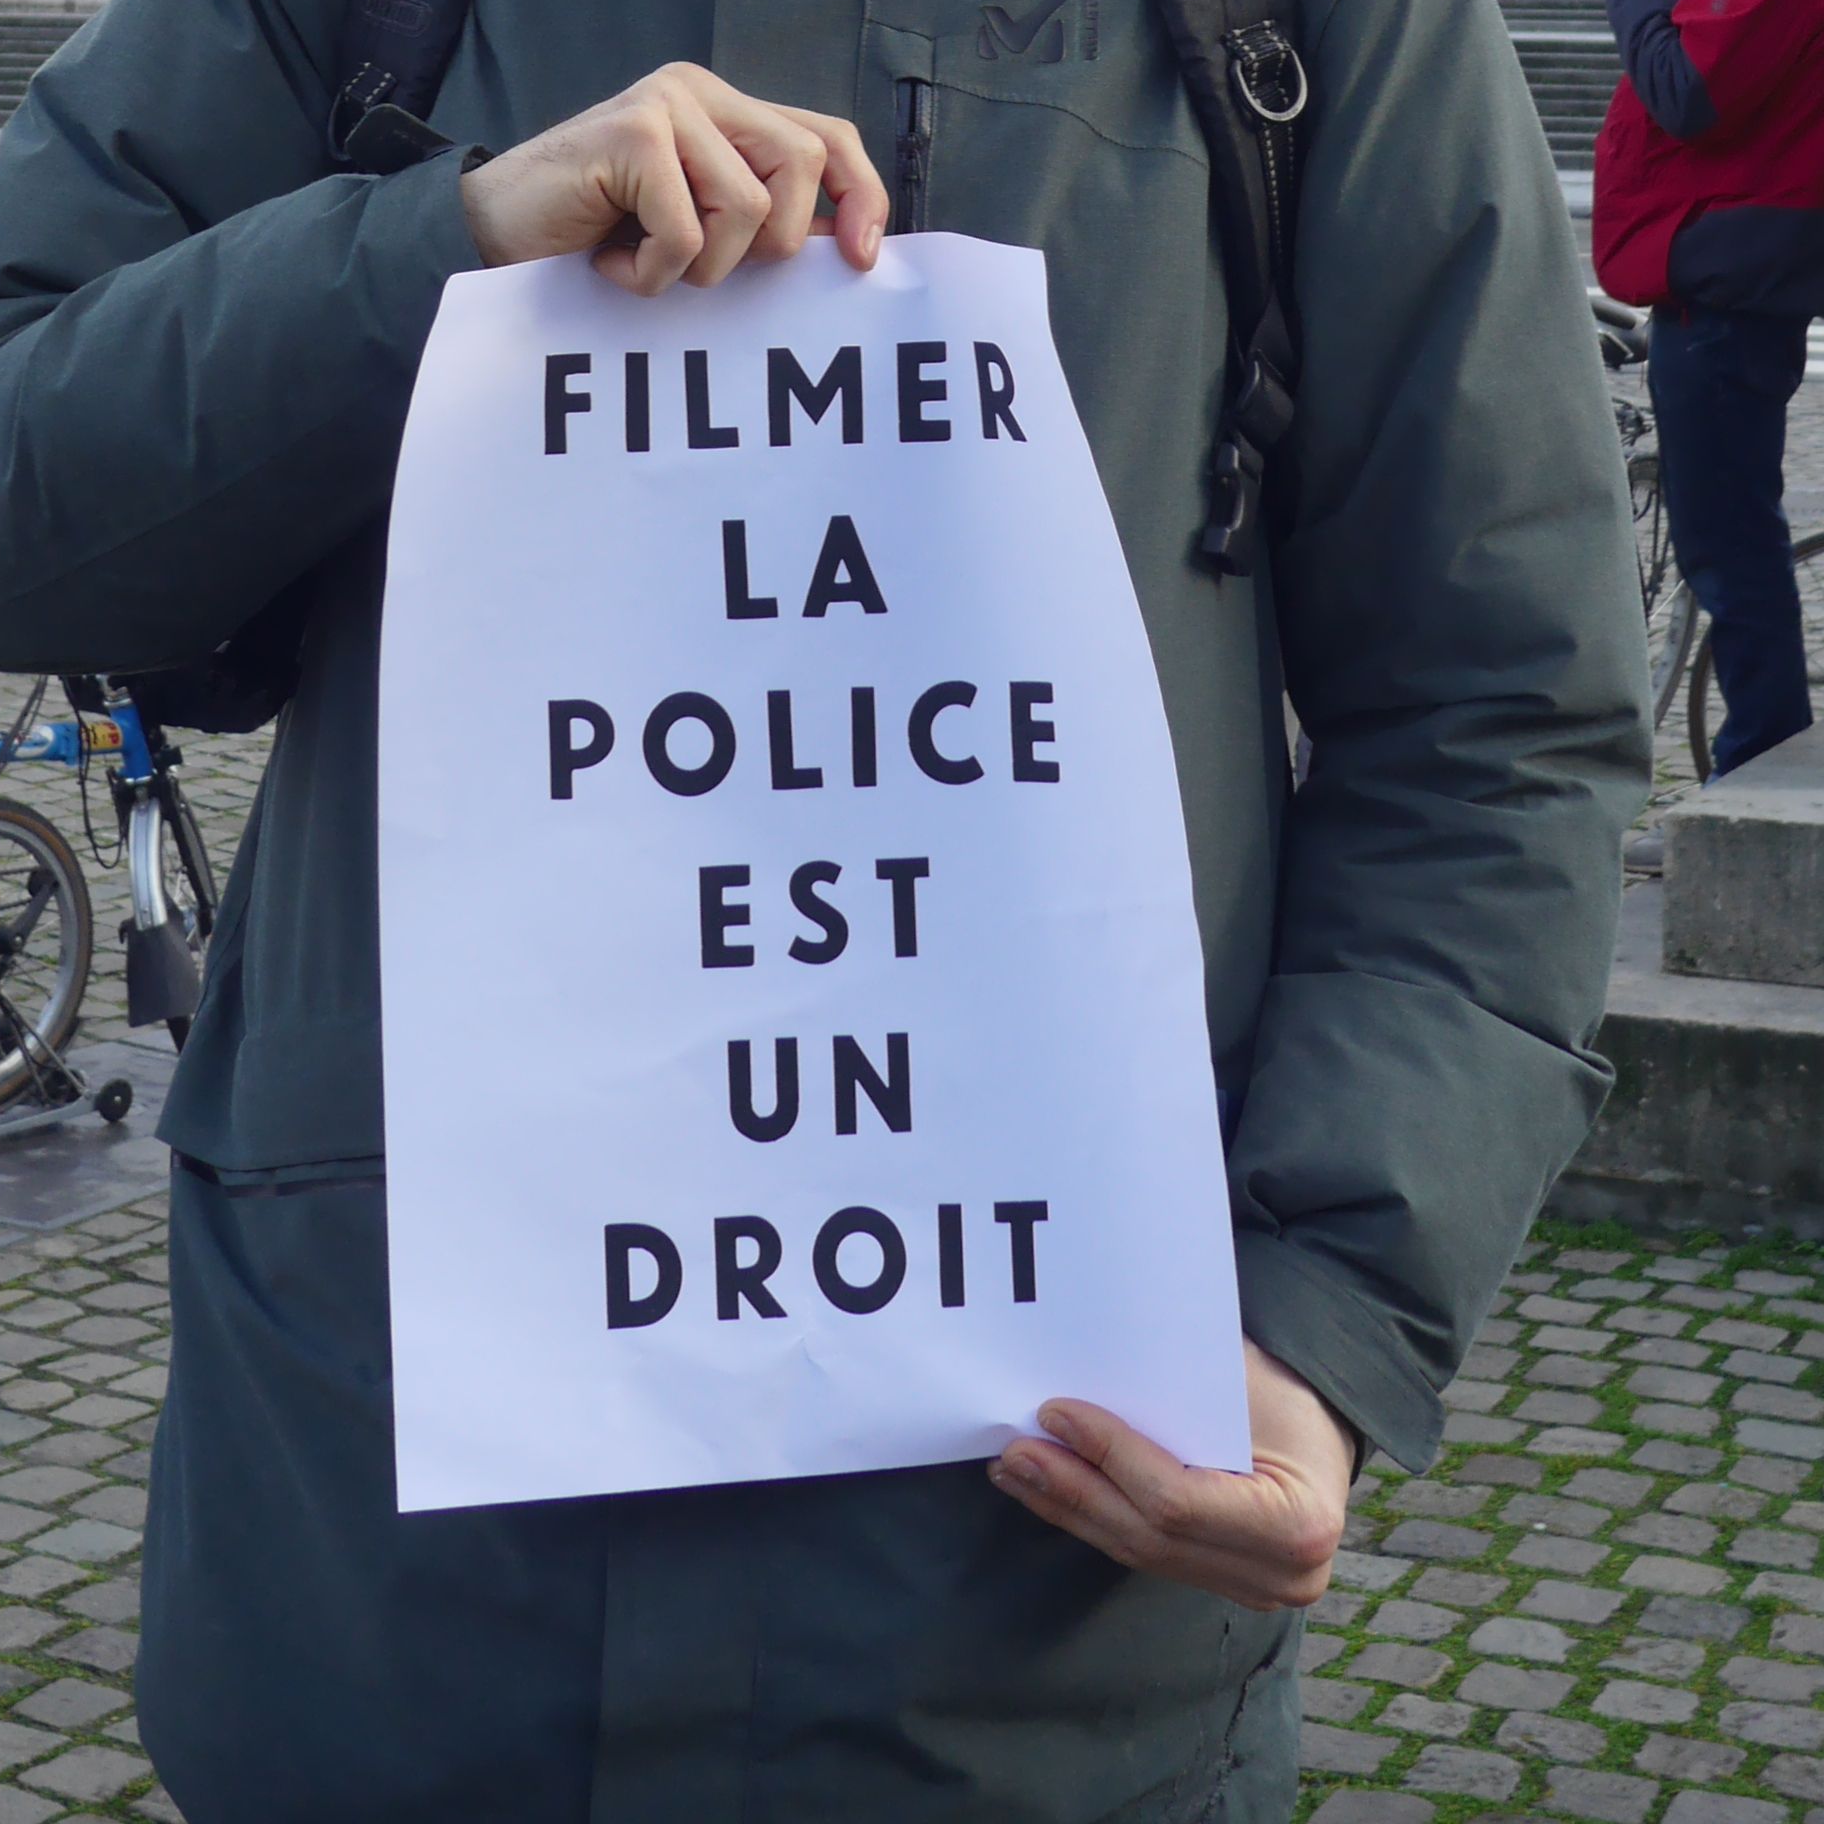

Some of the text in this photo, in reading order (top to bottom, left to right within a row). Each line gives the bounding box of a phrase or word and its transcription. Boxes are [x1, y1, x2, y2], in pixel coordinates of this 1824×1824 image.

[543, 342, 1027, 455] FILMER
[722, 515, 888, 620] LA
[547, 681, 1060, 800] POLICE
[698, 856, 931, 970] EST
[727, 1032, 913, 1143] UN
[604, 1199, 1050, 1330] DROIT
